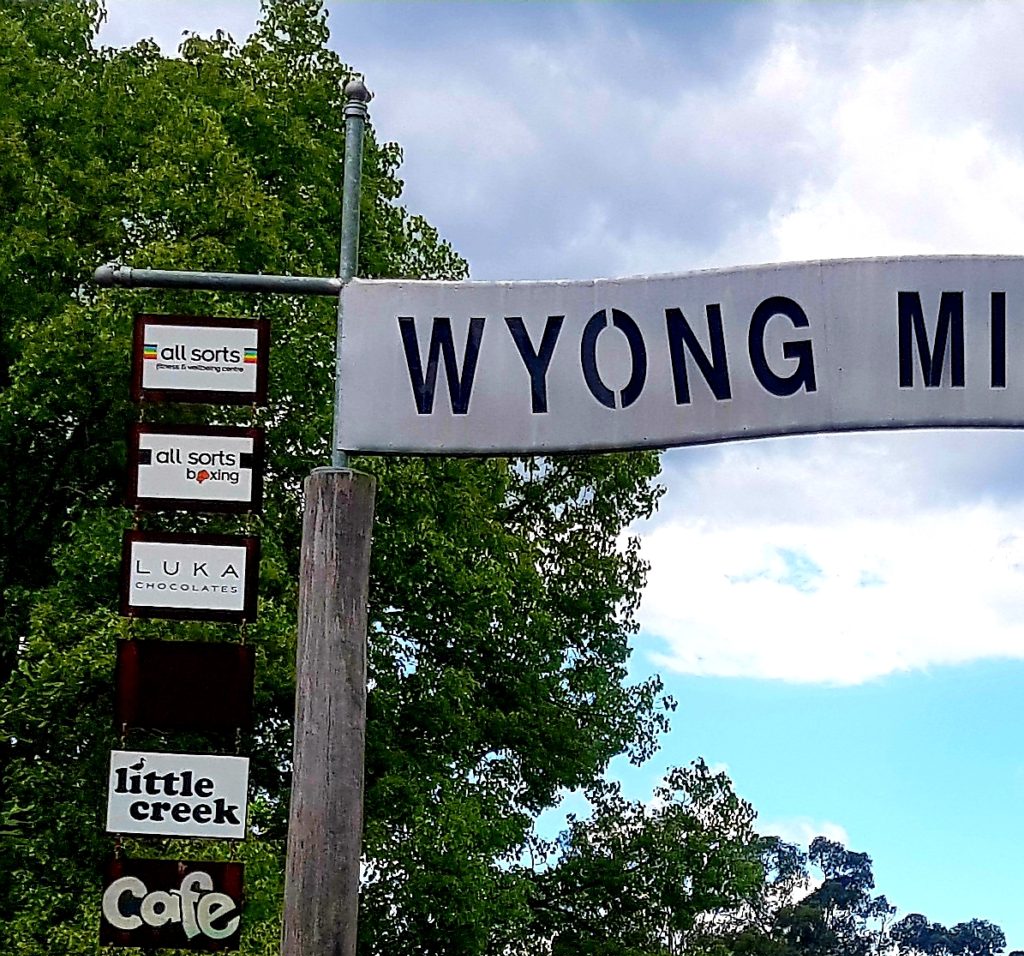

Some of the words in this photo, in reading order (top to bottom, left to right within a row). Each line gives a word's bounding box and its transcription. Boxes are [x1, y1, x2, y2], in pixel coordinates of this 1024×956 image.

[161, 345, 186, 360] all
[191, 347, 240, 363] sorts
[398, 295, 817, 415] WYONG
[156, 448, 182, 465] all
[188, 450, 236, 466] sorts
[136, 560, 239, 578] LUKA
[135, 581, 237, 593] CHOCOLATES
[114, 766, 214, 798] little
[129, 798, 240, 825] creek
[102, 871, 240, 940] Cafe
